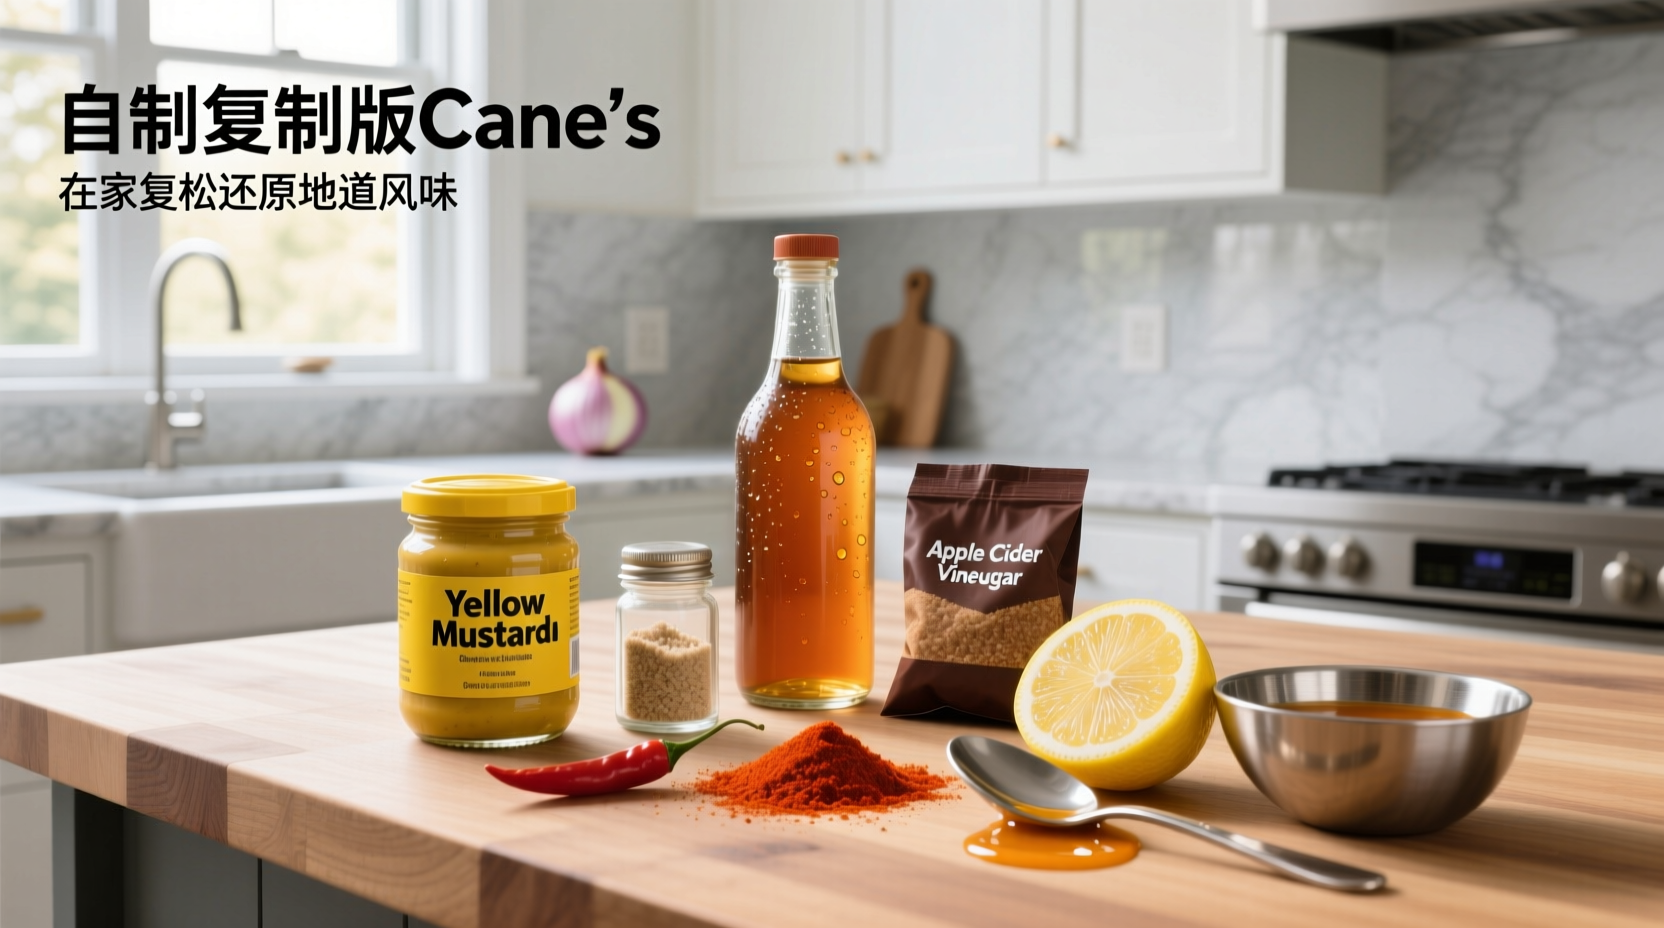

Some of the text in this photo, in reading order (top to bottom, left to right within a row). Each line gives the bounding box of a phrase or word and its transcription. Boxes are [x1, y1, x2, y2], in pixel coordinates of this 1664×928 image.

[926, 540, 1043, 565] Apple Cider
[937, 563, 1024, 591] Vineugar
[444, 588, 546, 618] Yellow
